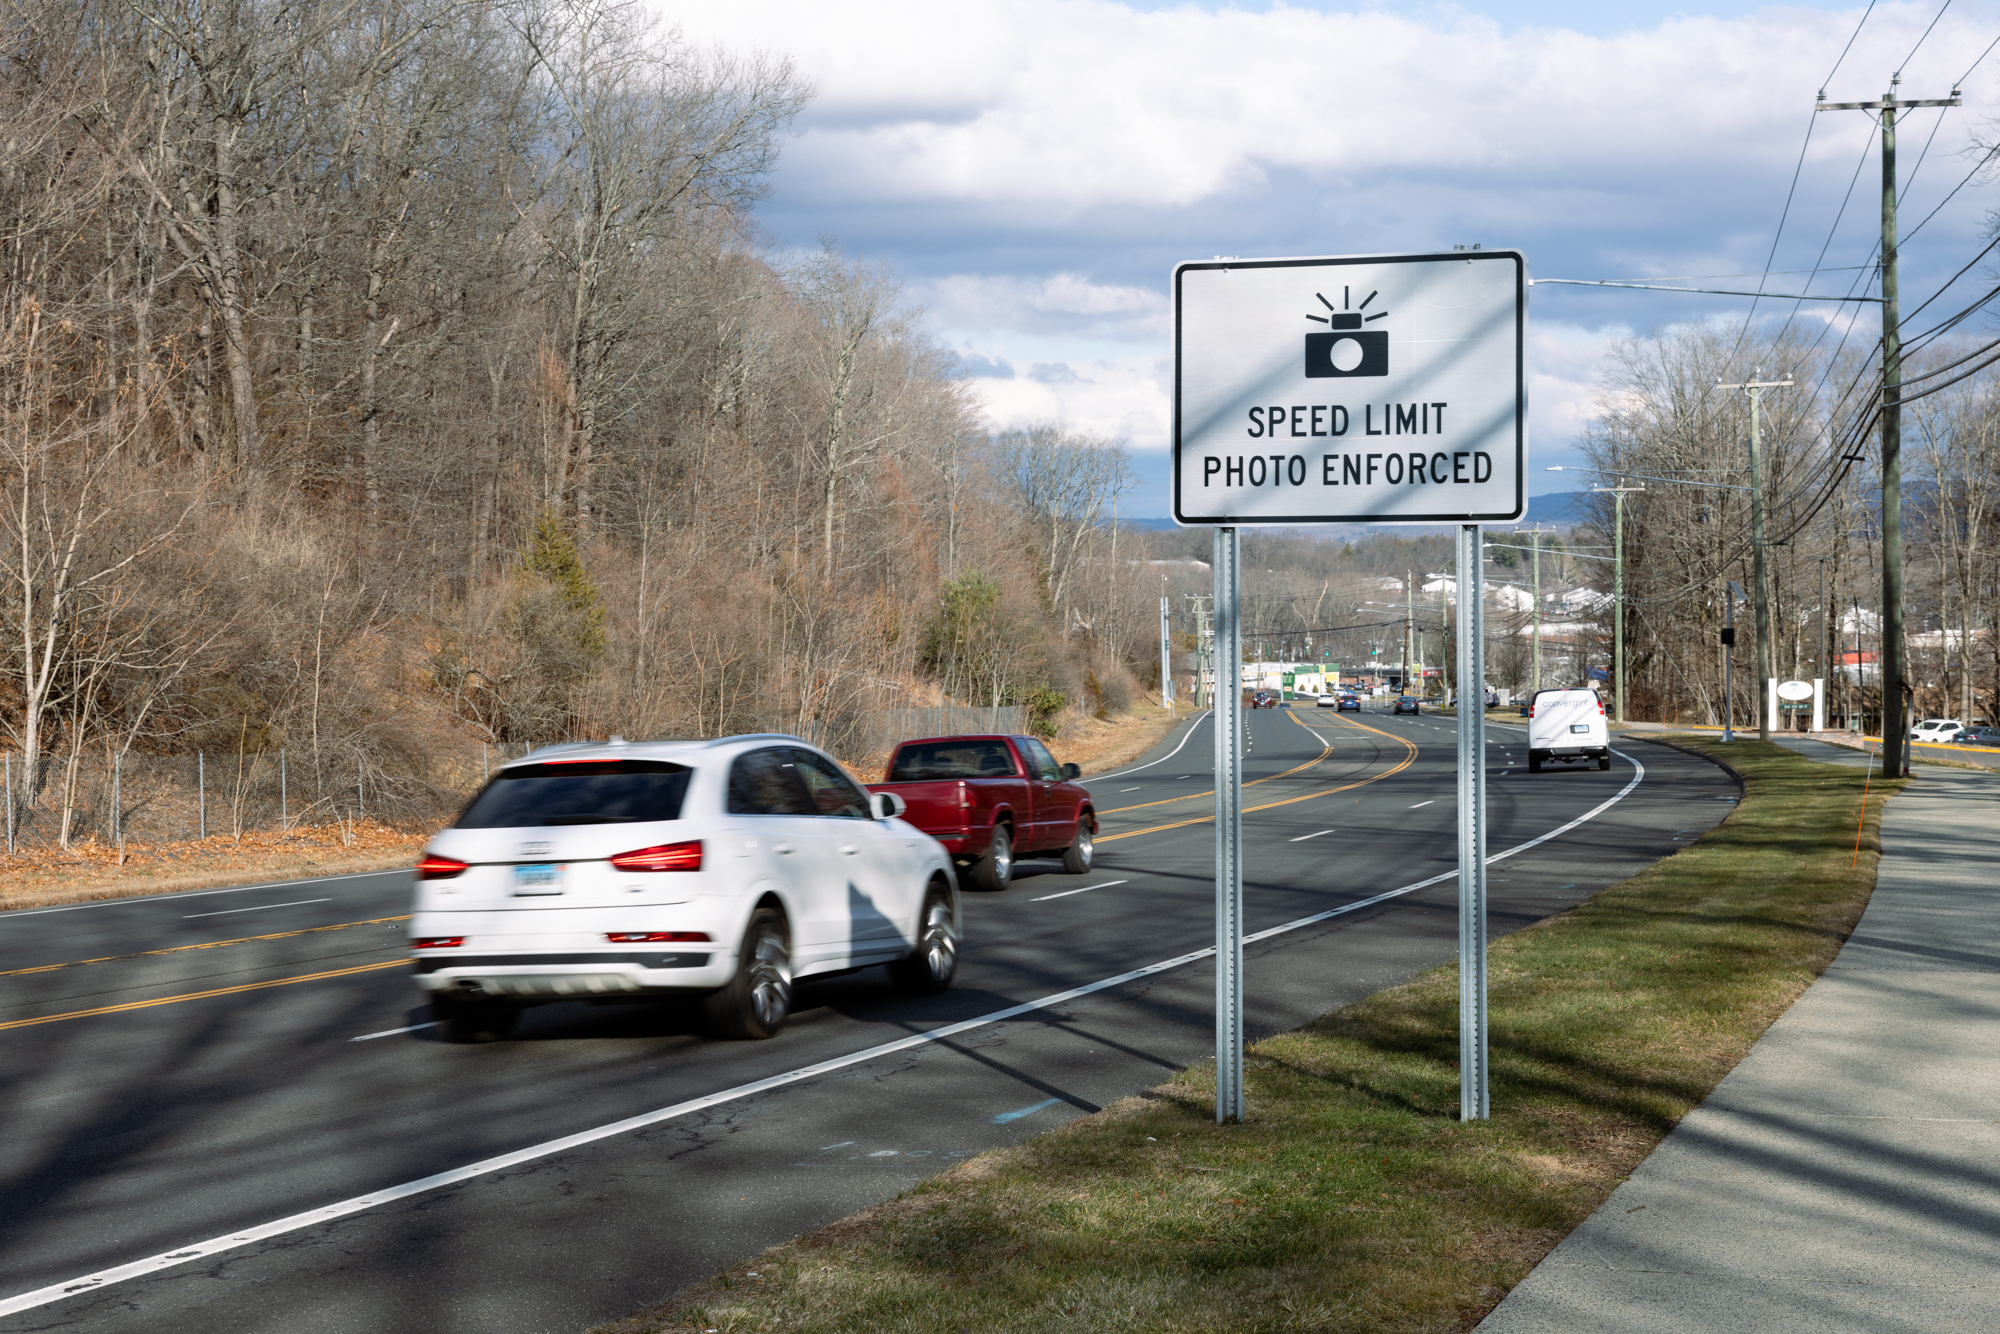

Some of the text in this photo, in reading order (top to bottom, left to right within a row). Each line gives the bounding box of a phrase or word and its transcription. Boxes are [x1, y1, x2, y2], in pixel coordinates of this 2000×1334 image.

[1247, 402, 1448, 438] SPEED LIMIT
[1204, 451, 1492, 487] PHOTO ENFORCED
[1542, 699, 1588, 708] convergint
